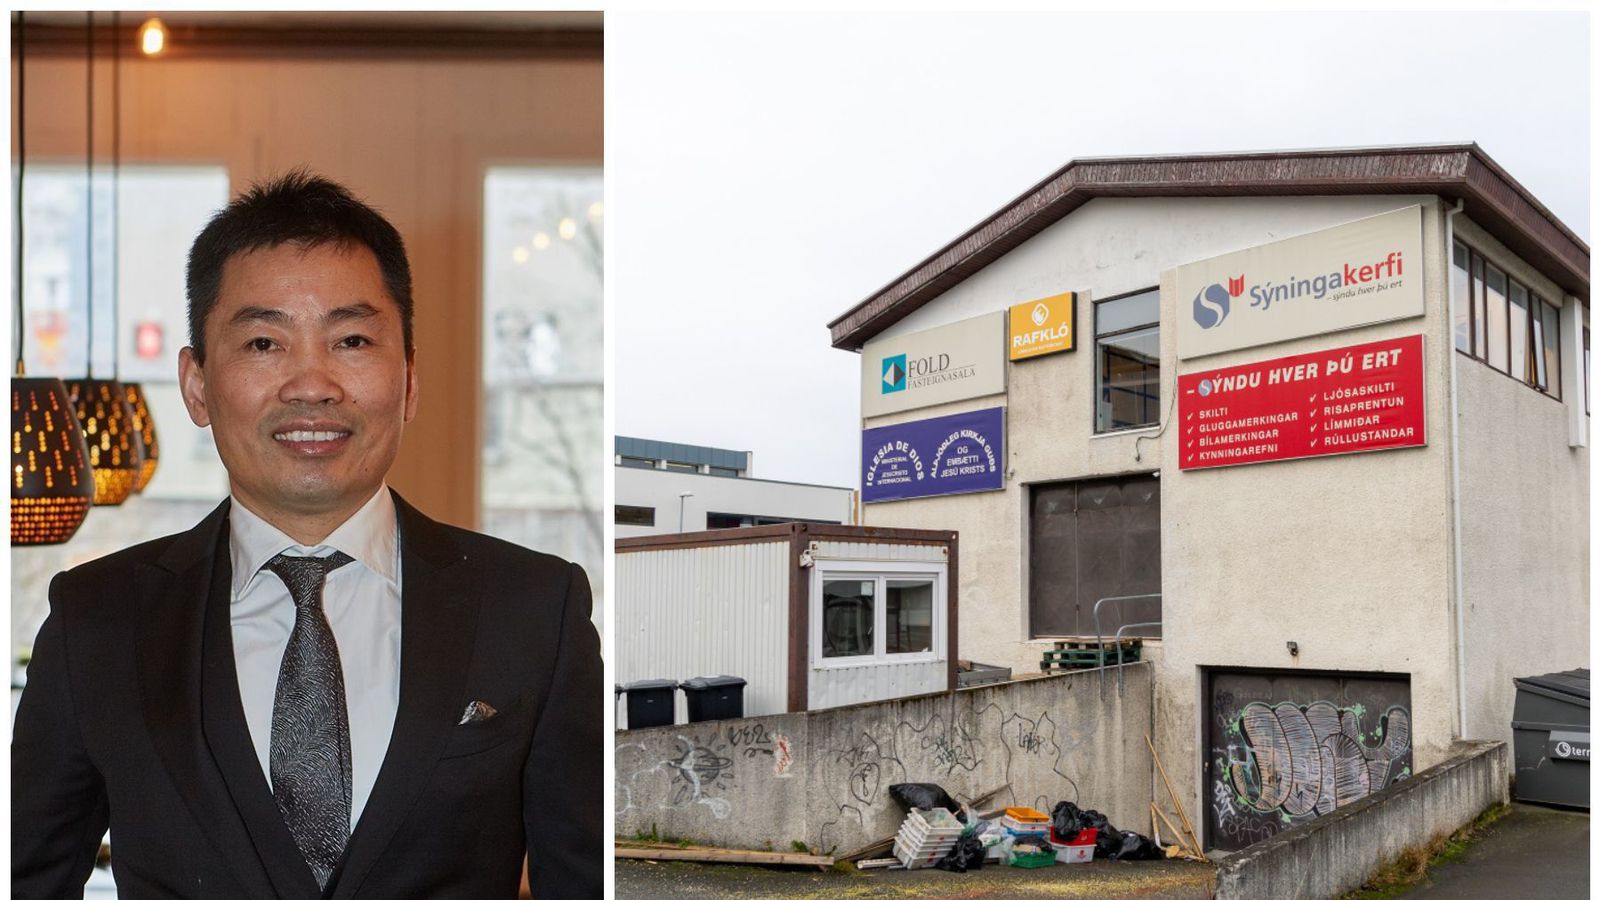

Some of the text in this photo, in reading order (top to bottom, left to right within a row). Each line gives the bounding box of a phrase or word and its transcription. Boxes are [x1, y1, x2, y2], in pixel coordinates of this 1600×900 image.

[1250, 252, 1403, 310] Sýningakerfi
[1358, 284, 1375, 295] hver
[1391, 279, 1402, 289] ert
[1013, 323, 1069, 348] RAFKLÓ
[908, 353, 950, 378] FOLD
[1268, 363, 1319, 385] HVER
[1326, 352, 1354, 376] ÞÚ
[1362, 348, 1403, 370] ERT
[908, 368, 976, 390] FASTEIGNASALA
[1323, 382, 1395, 401] LJÓSASKILTI
[1199, 407, 1228, 419] SKILTI
[1323, 397, 1405, 416] RISAPRENTUN
[1199, 412, 1299, 433] GLUGGAMERKINGAR
[1323, 415, 1381, 431] LÍMMIÐAR
[961, 429, 986, 447] KIRKJA
[1199, 429, 1280, 447] BÍLAMERKINGAR
[1324, 427, 1415, 446] RÚLLUSTANDAR
[957, 445, 969, 454] OG
[1199, 444, 1279, 460] KYNNINGAREFNI
[866, 440, 925, 486] IGLESIA DE DIOS
[947, 455, 979, 467] EMBÆTTI
[959, 464, 986, 475] KRISTS
